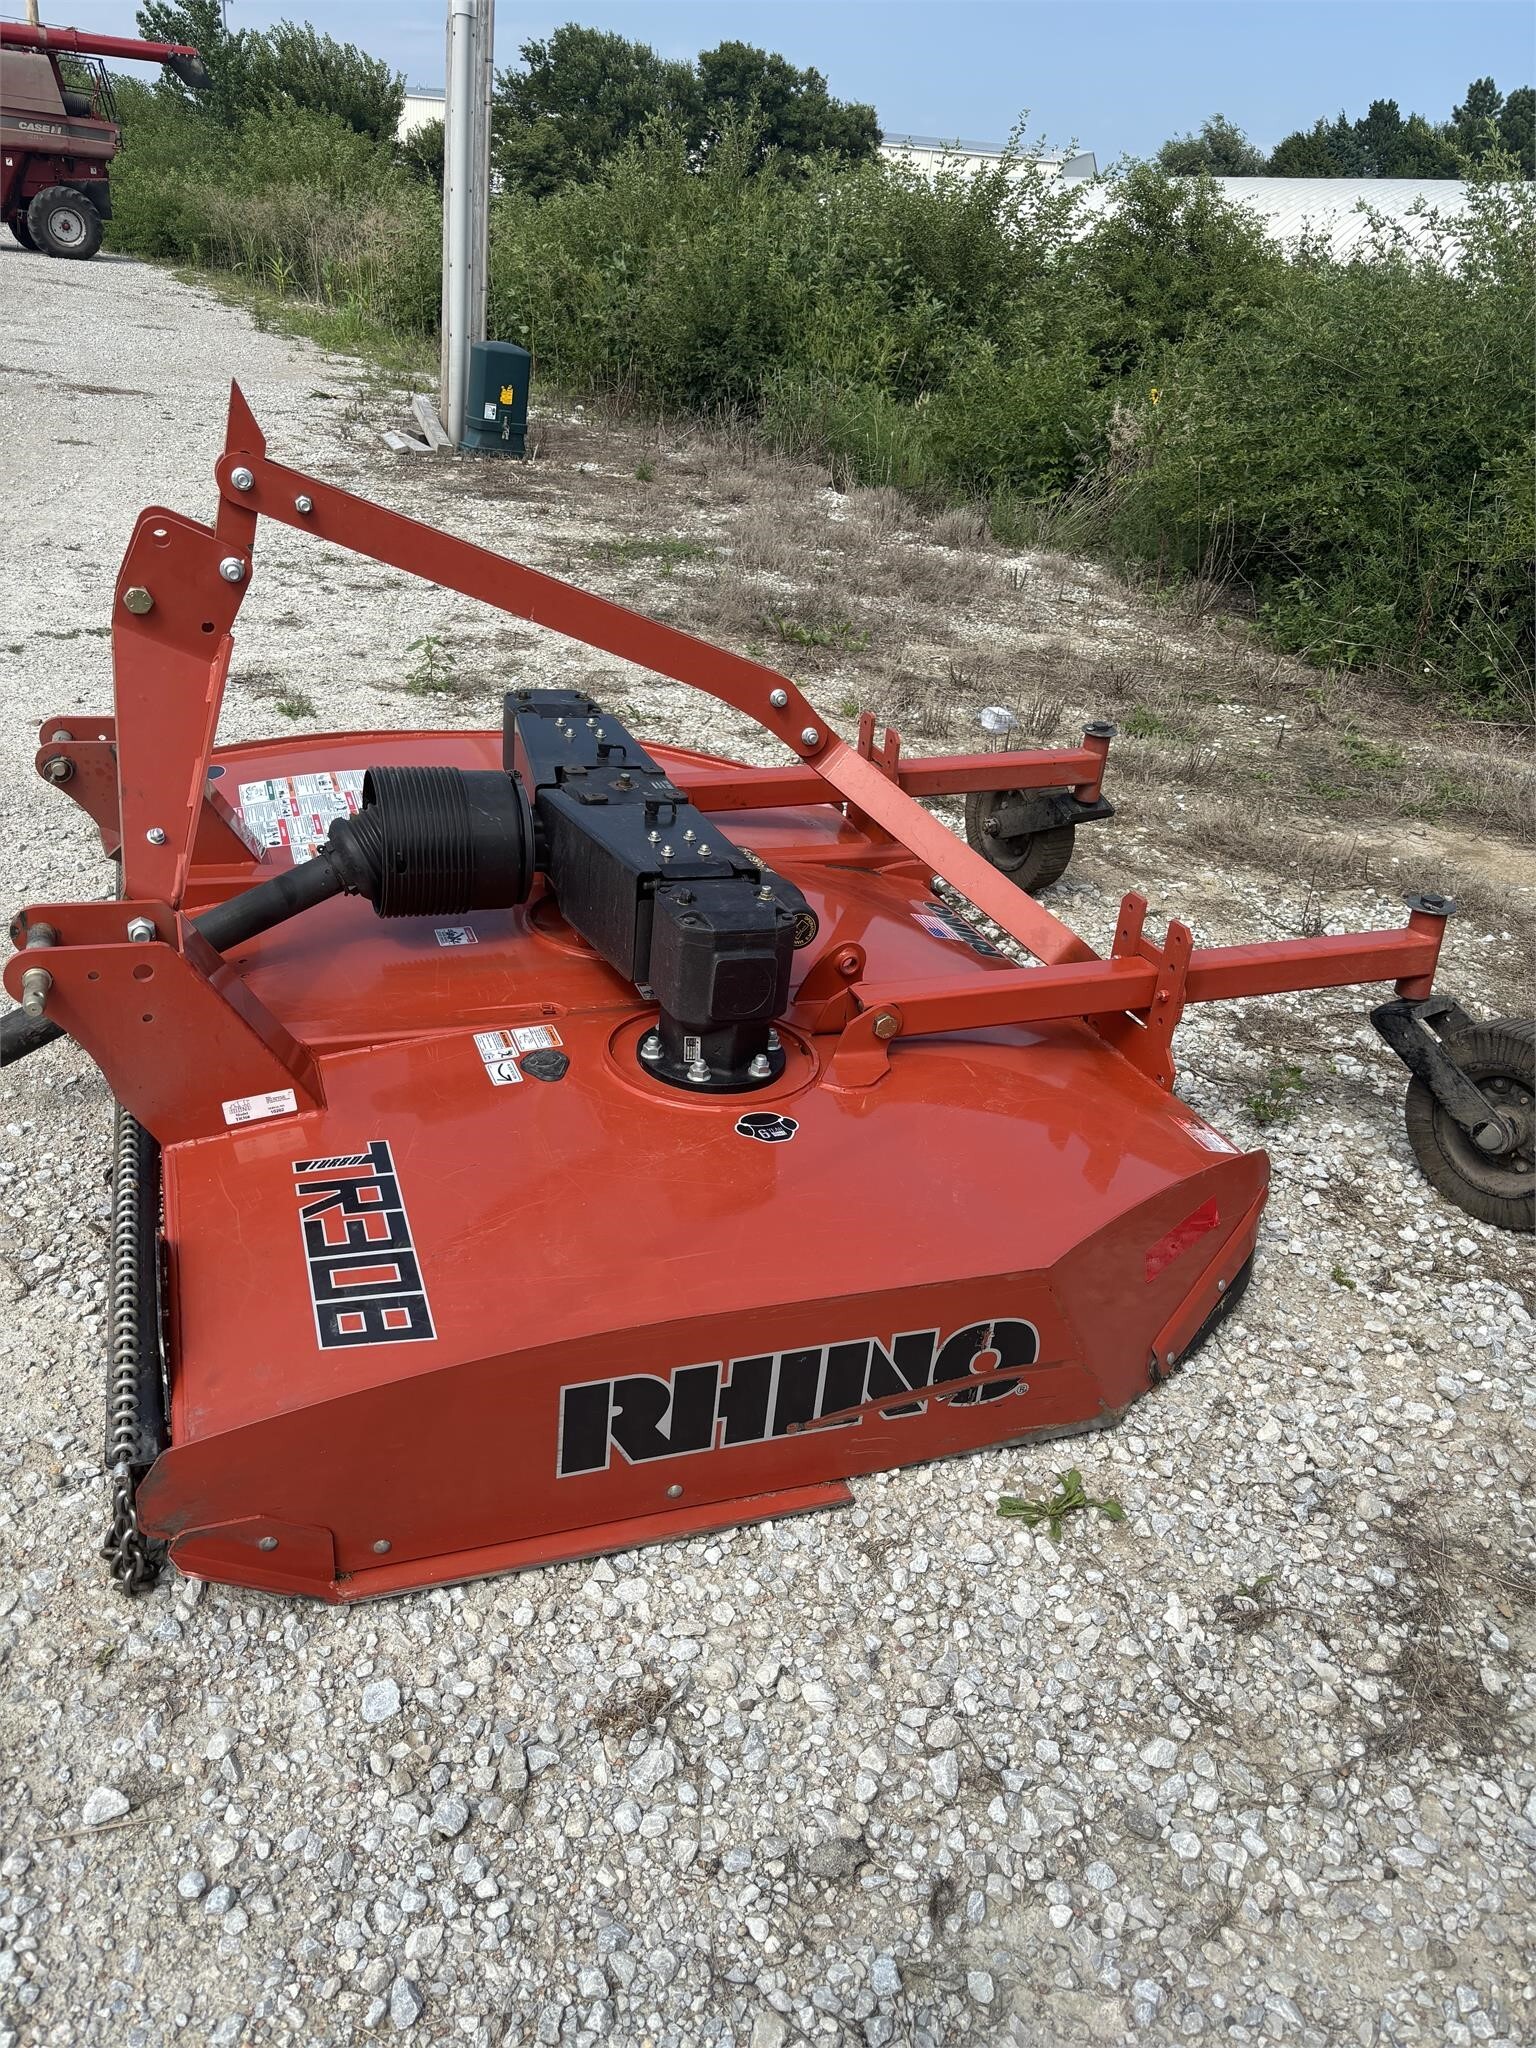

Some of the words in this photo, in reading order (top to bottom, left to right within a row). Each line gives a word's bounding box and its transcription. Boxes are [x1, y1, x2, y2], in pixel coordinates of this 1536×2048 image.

[758, 1129, 771, 1138] 6
[307, 1155, 365, 1170] TURBO
[556, 1318, 1041, 1478] RHINO
